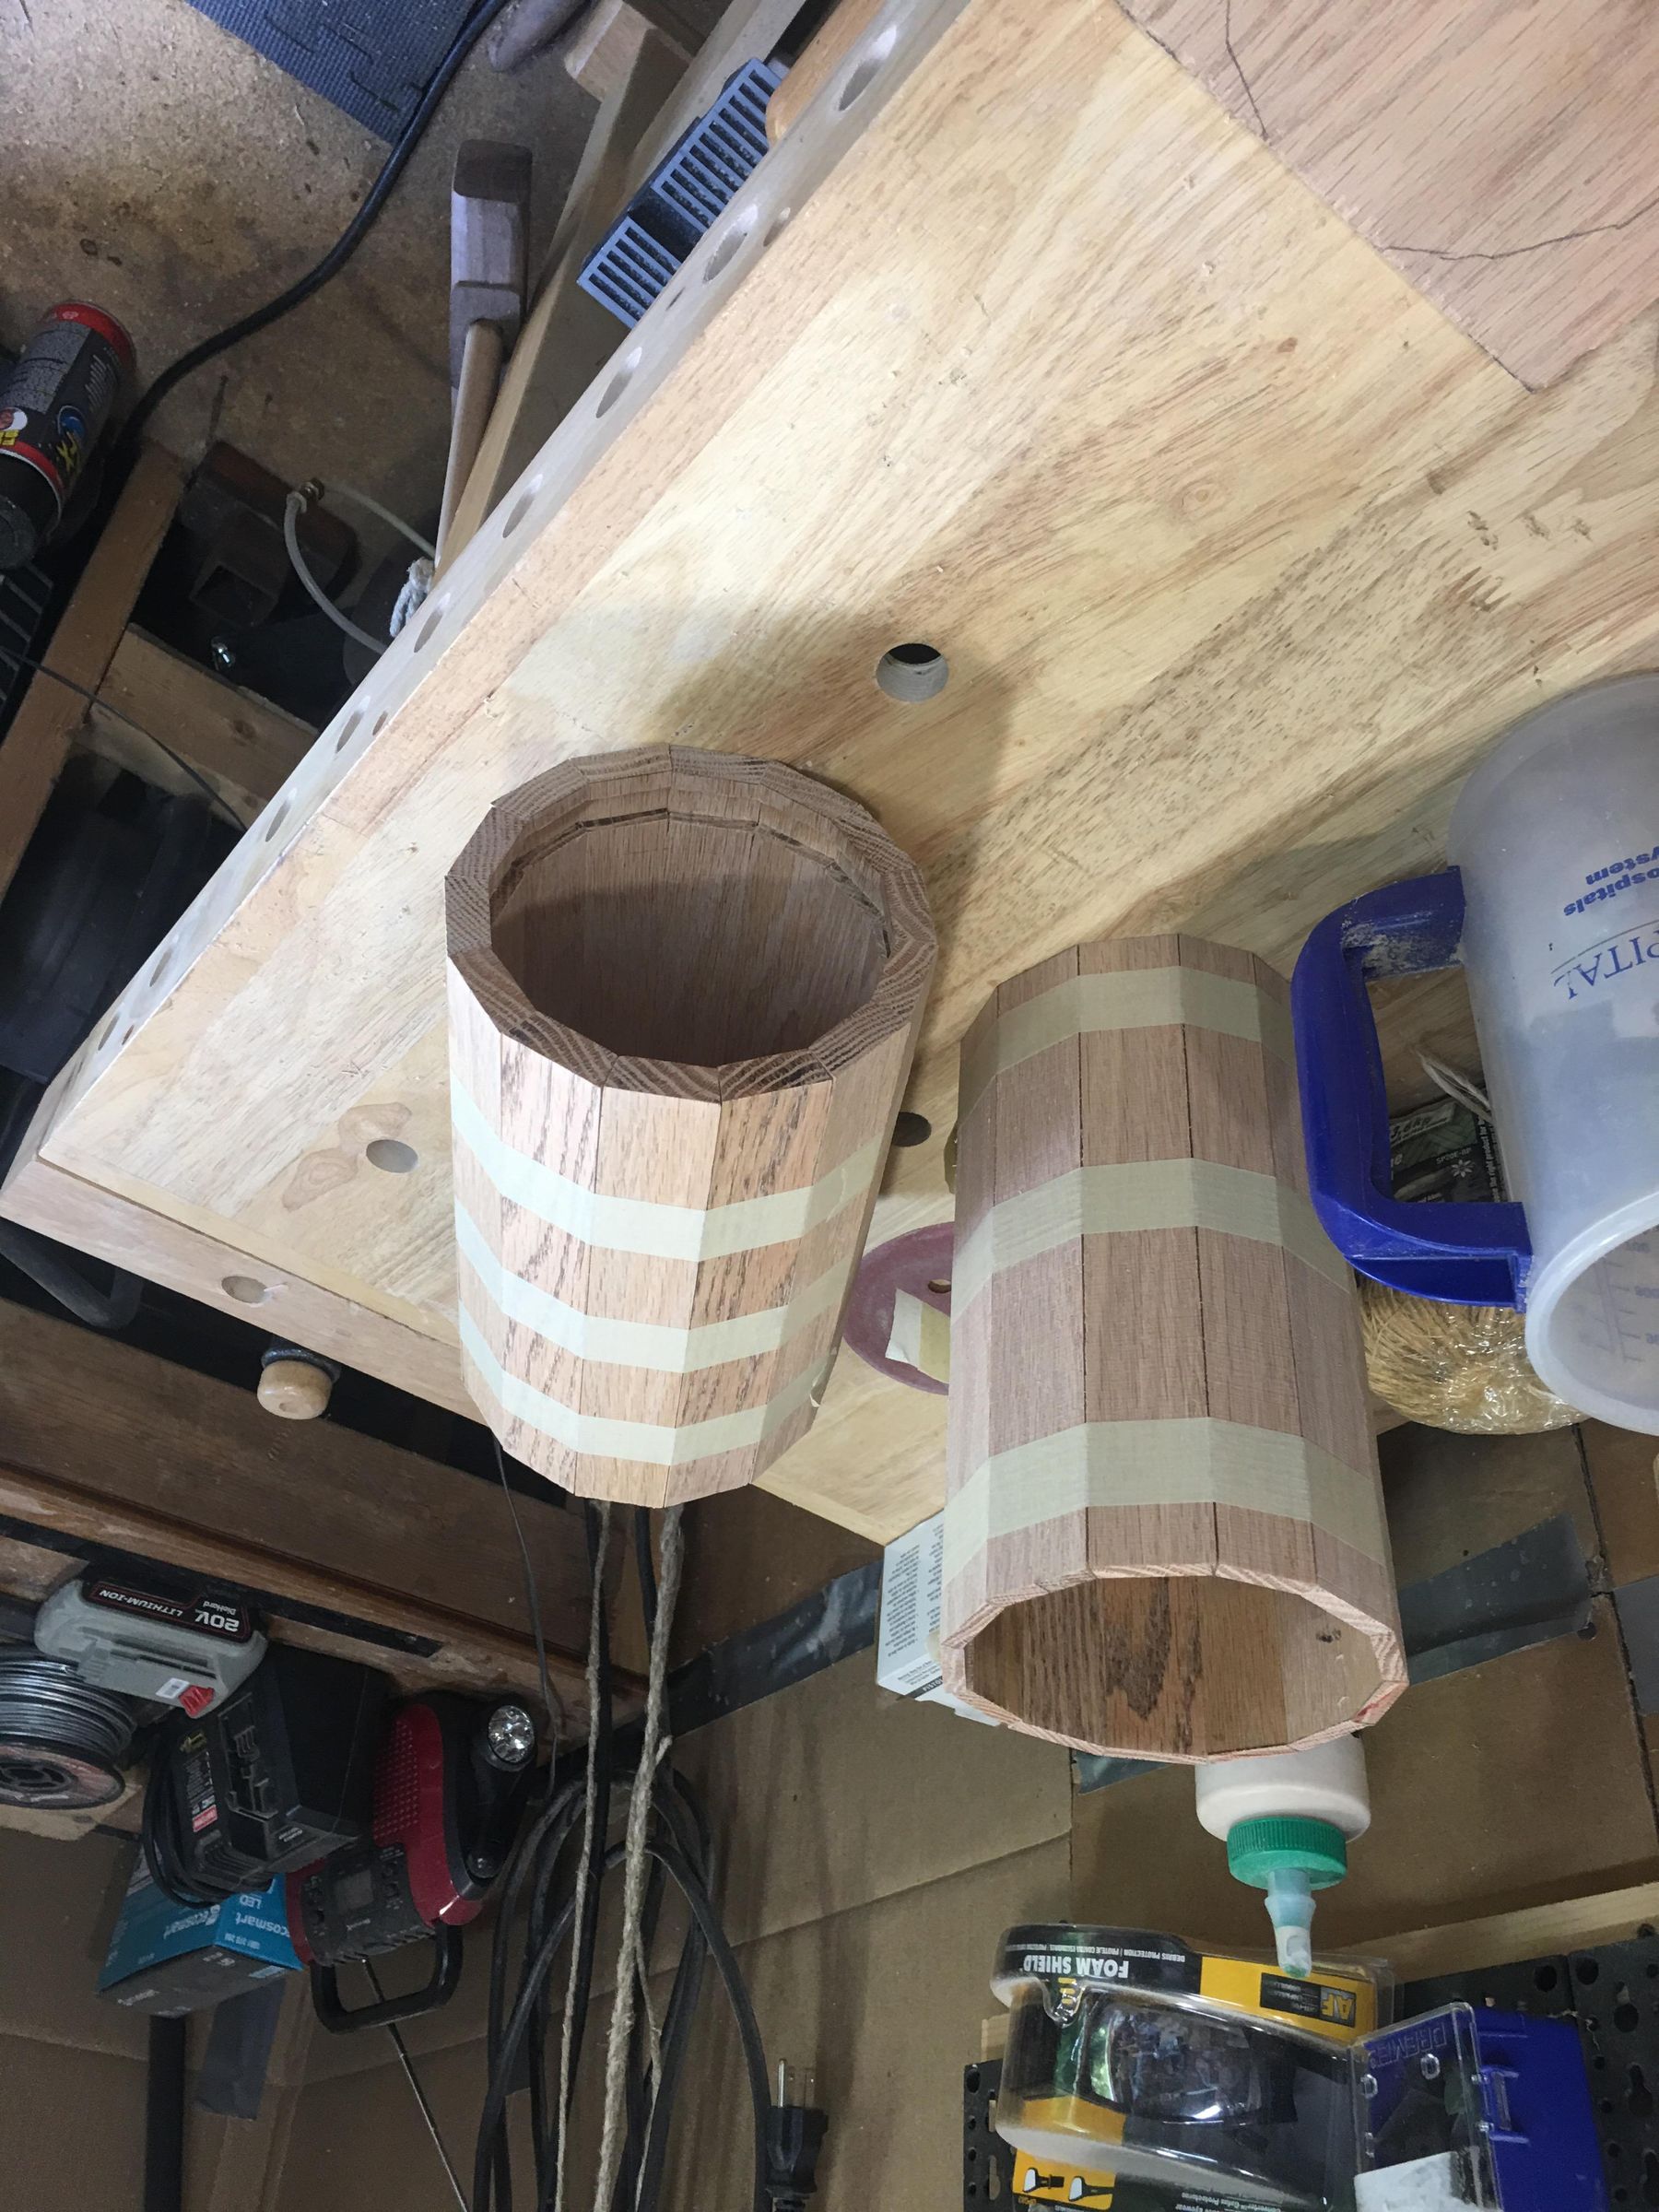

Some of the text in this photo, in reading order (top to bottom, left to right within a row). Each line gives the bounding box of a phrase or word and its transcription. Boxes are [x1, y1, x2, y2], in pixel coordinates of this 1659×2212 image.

[1585, 845, 1659, 886] ystem
[1563, 867, 1659, 916] ospitals
[1553, 929, 1659, 1000] PITAL
[99, 1589, 183, 1618] LITHIUM-ION
[203, 1600, 237, 1617] DieHard
[239, 1893, 263, 1910] LED
[235, 1912, 291, 1938] cosmart
[1023, 1954, 1130, 1979] FOAM SHIELD
[1322, 1993, 1354, 2021] AF
